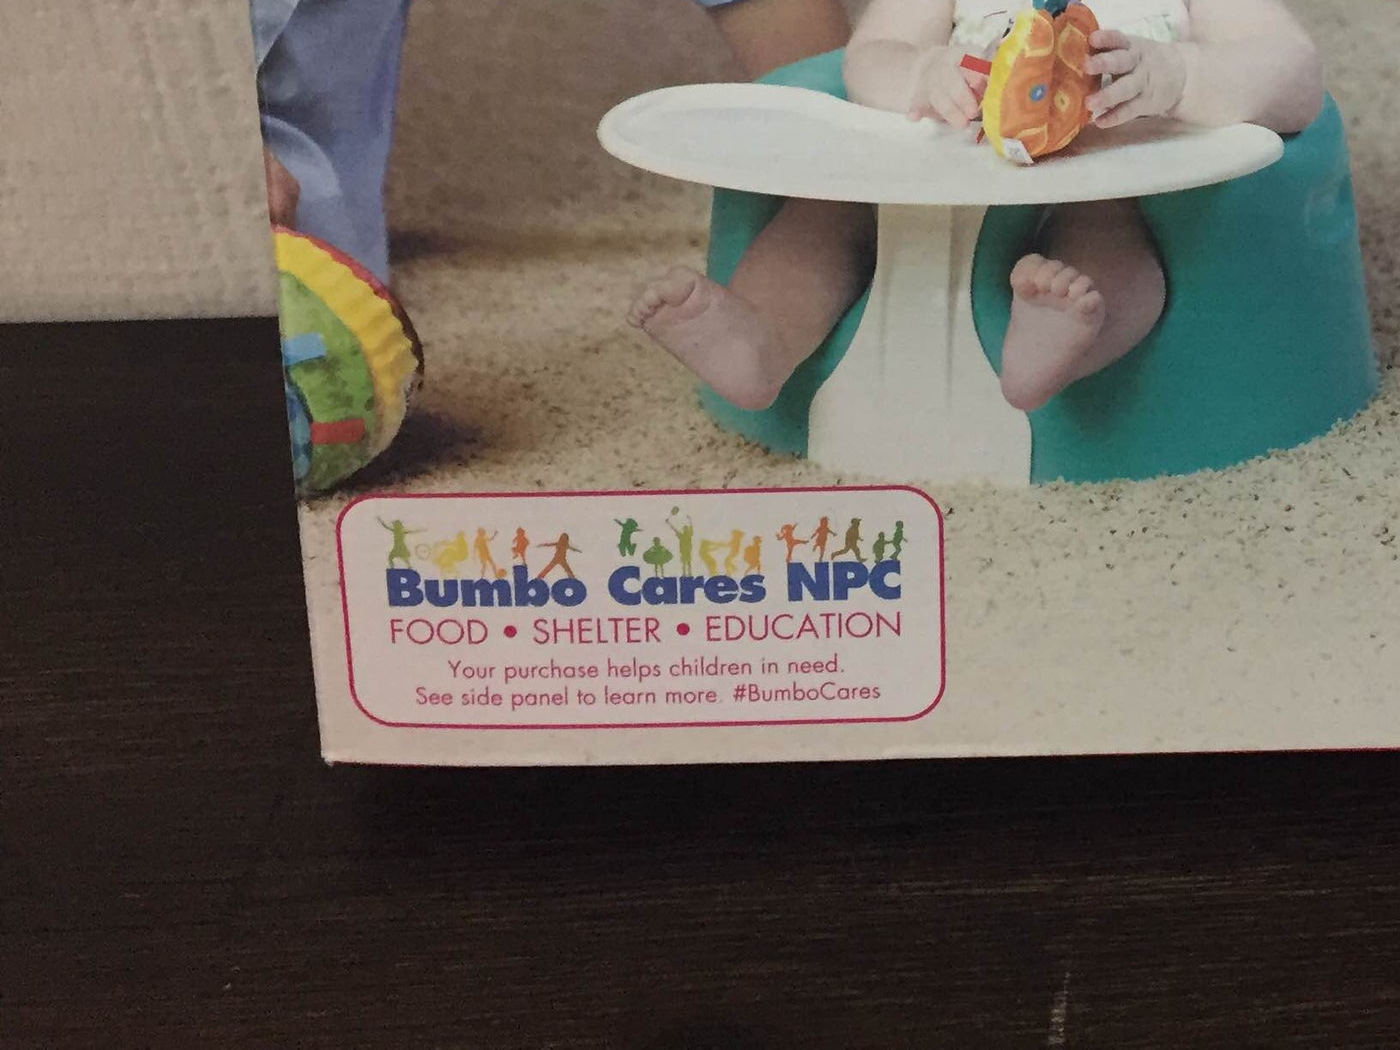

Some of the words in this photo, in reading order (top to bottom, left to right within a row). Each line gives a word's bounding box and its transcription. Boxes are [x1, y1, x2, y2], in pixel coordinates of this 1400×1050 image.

[387, 565, 587, 607] Bumbo
[607, 565, 767, 605] Cares
[786, 561, 902, 602] NPC
[390, 619, 488, 645] FOOD
[534, 618, 660, 644] SHELTER
[706, 612, 900, 641] EDUCATION
[448, 660, 495, 679] Your
[505, 659, 598, 684] purchase
[608, 656, 661, 682] helps
[670, 656, 751, 676] children
[761, 656, 778, 674] in
[788, 653, 844, 673] need.
[416, 687, 453, 705] See
[462, 686, 502, 706] side
[512, 686, 568, 711] panel
[577, 688, 597, 705] to
[605, 686, 655, 705] learn
[733, 682, 881, 703] #BumboCares
